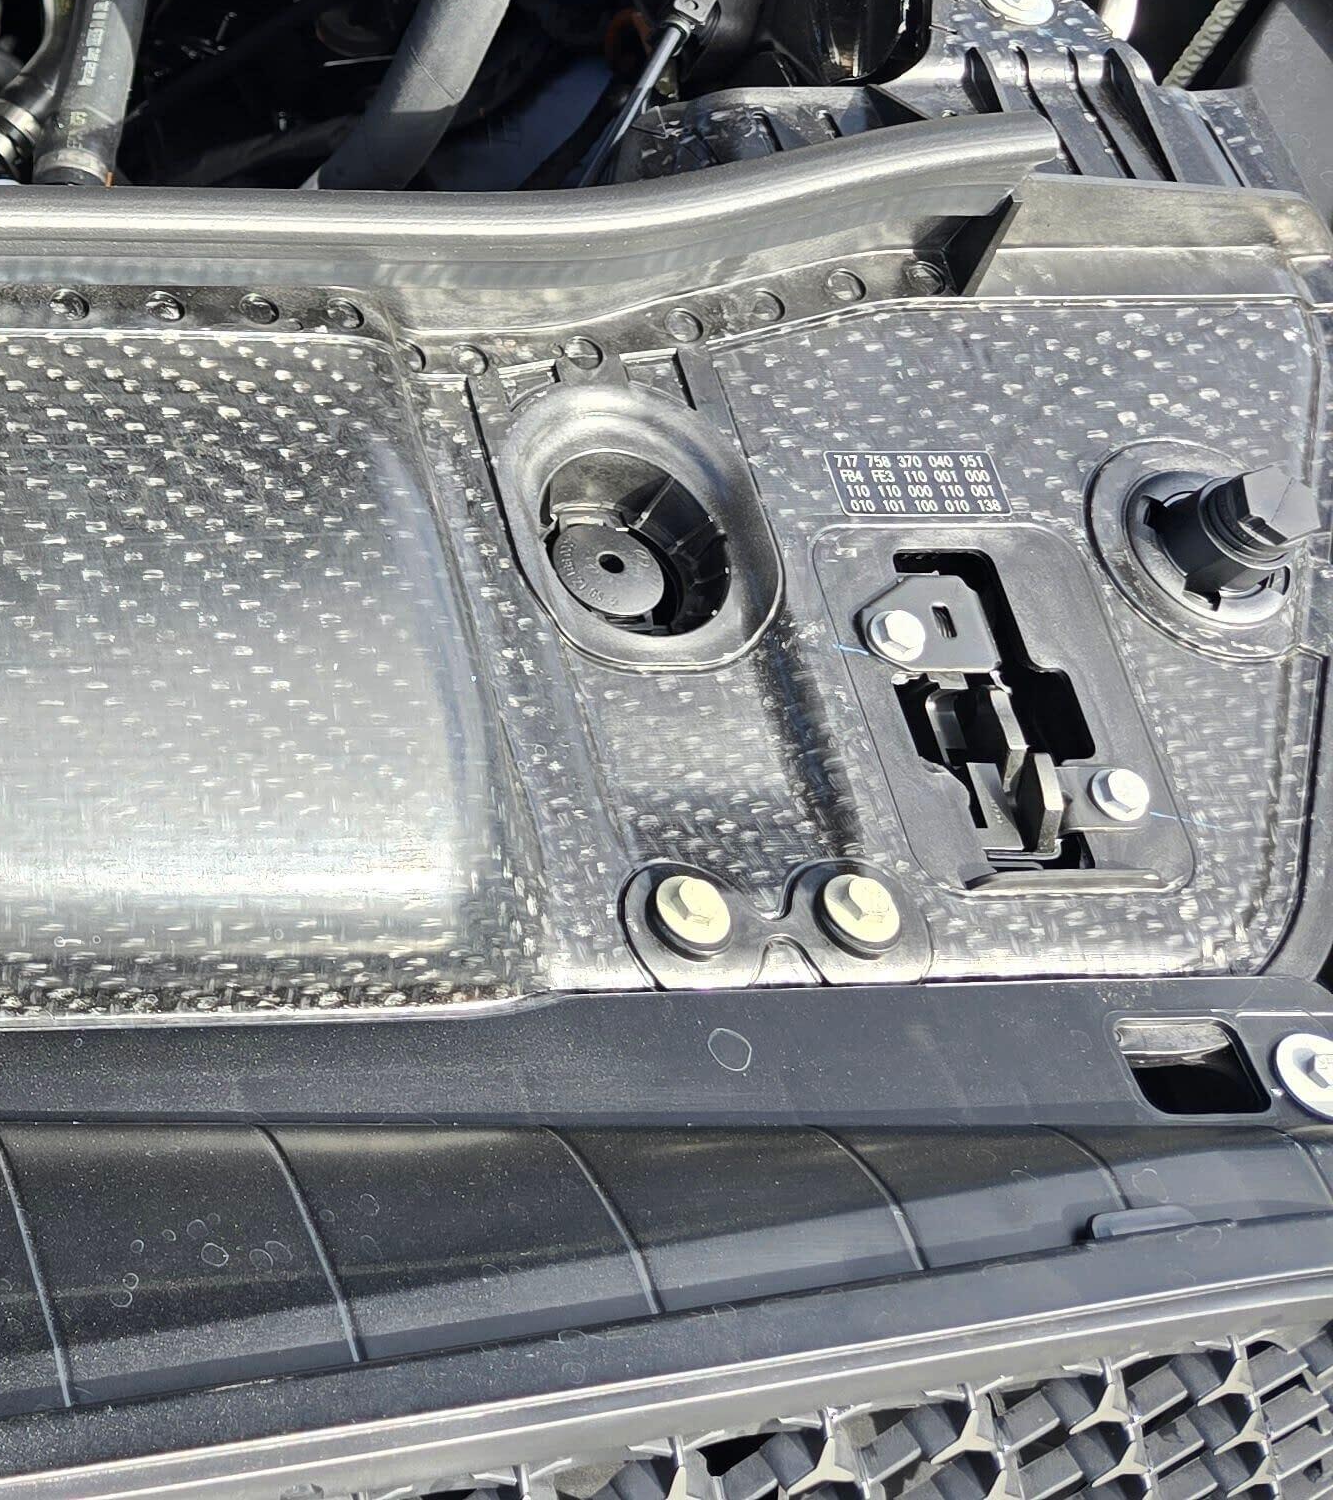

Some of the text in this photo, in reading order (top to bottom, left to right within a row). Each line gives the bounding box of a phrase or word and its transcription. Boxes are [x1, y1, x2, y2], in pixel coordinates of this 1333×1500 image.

[833, 454, 858, 468] 717
[896, 454, 922, 468] 370
[928, 454, 953, 468] 040
[959, 454, 983, 468] 951
[903, 469, 927, 483] 110
[933, 469, 958, 483] 001
[965, 469, 990, 483] 000
[846, 484, 995, 498] 110 110 000 110 001
[850, 499, 875, 513] 010
[882, 499, 906, 513] 101
[914, 499, 938, 513] 100
[944, 499, 970, 513] 010
